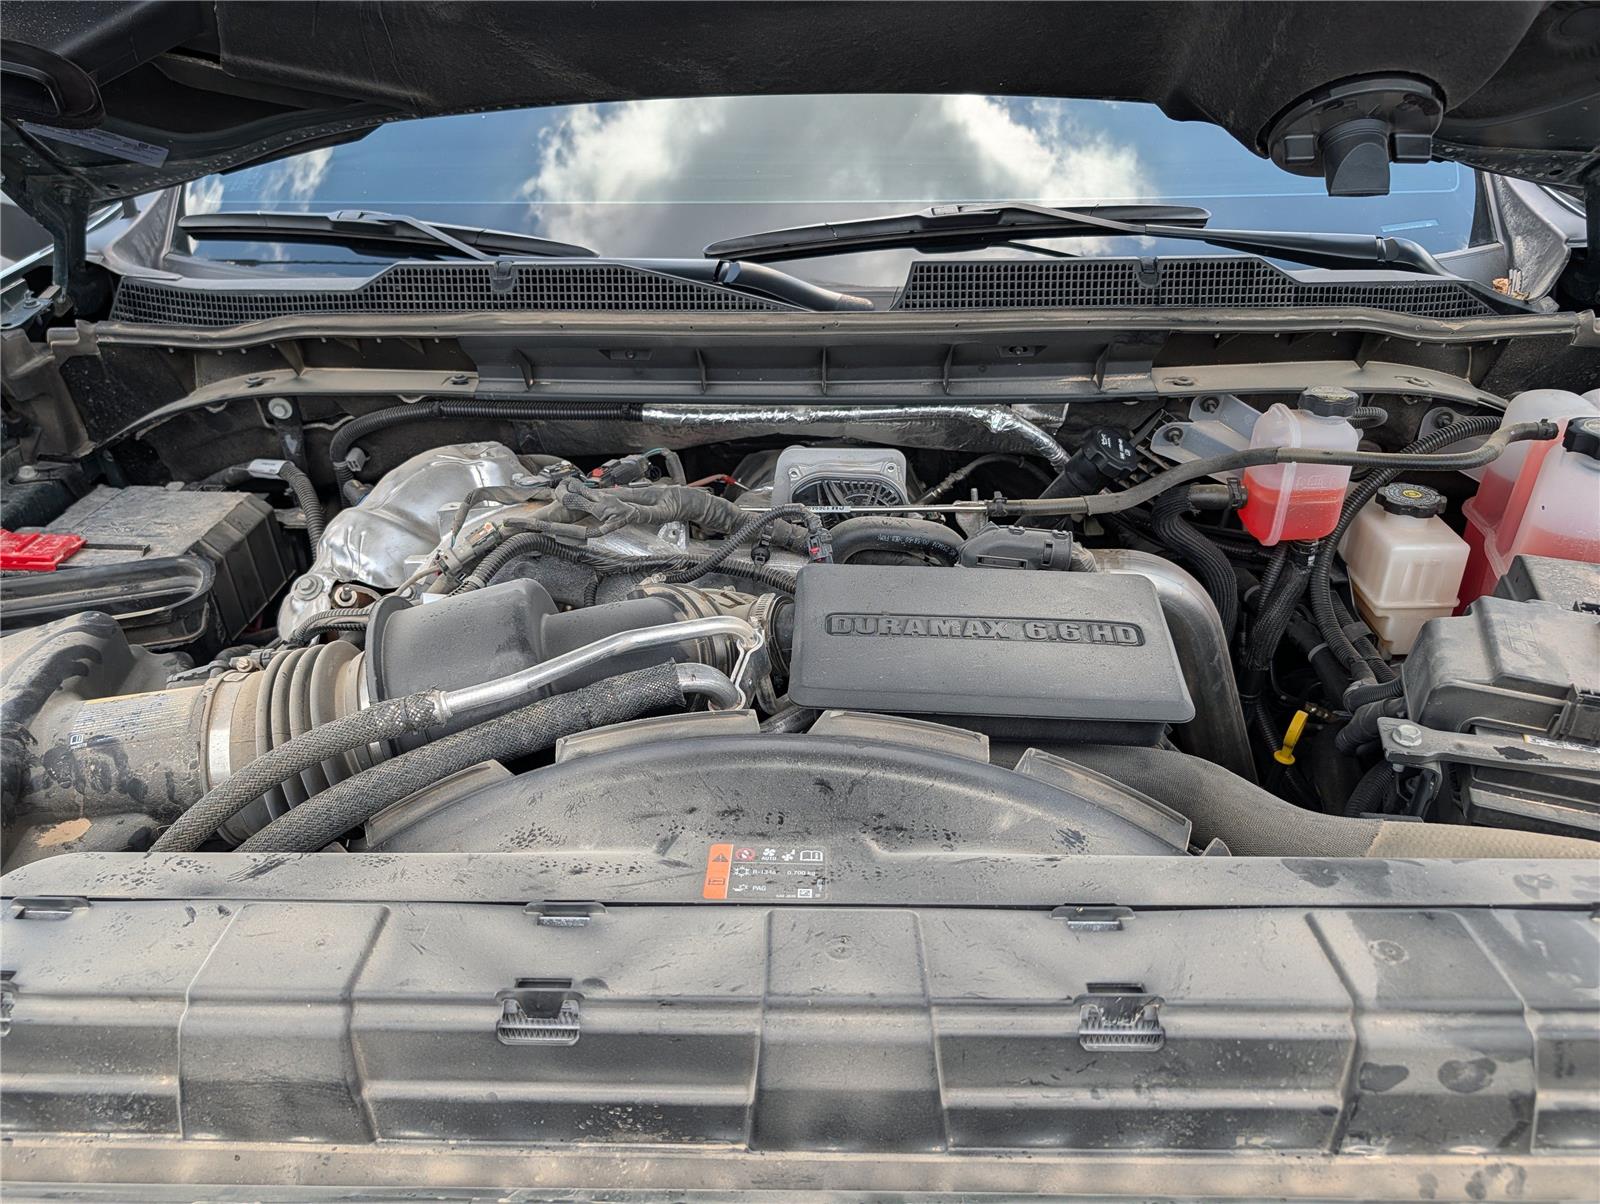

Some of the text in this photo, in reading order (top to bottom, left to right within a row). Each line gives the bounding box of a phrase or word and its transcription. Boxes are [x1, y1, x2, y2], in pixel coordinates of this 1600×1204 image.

[831, 616, 1139, 645] DURAMAX 6.6 HD
